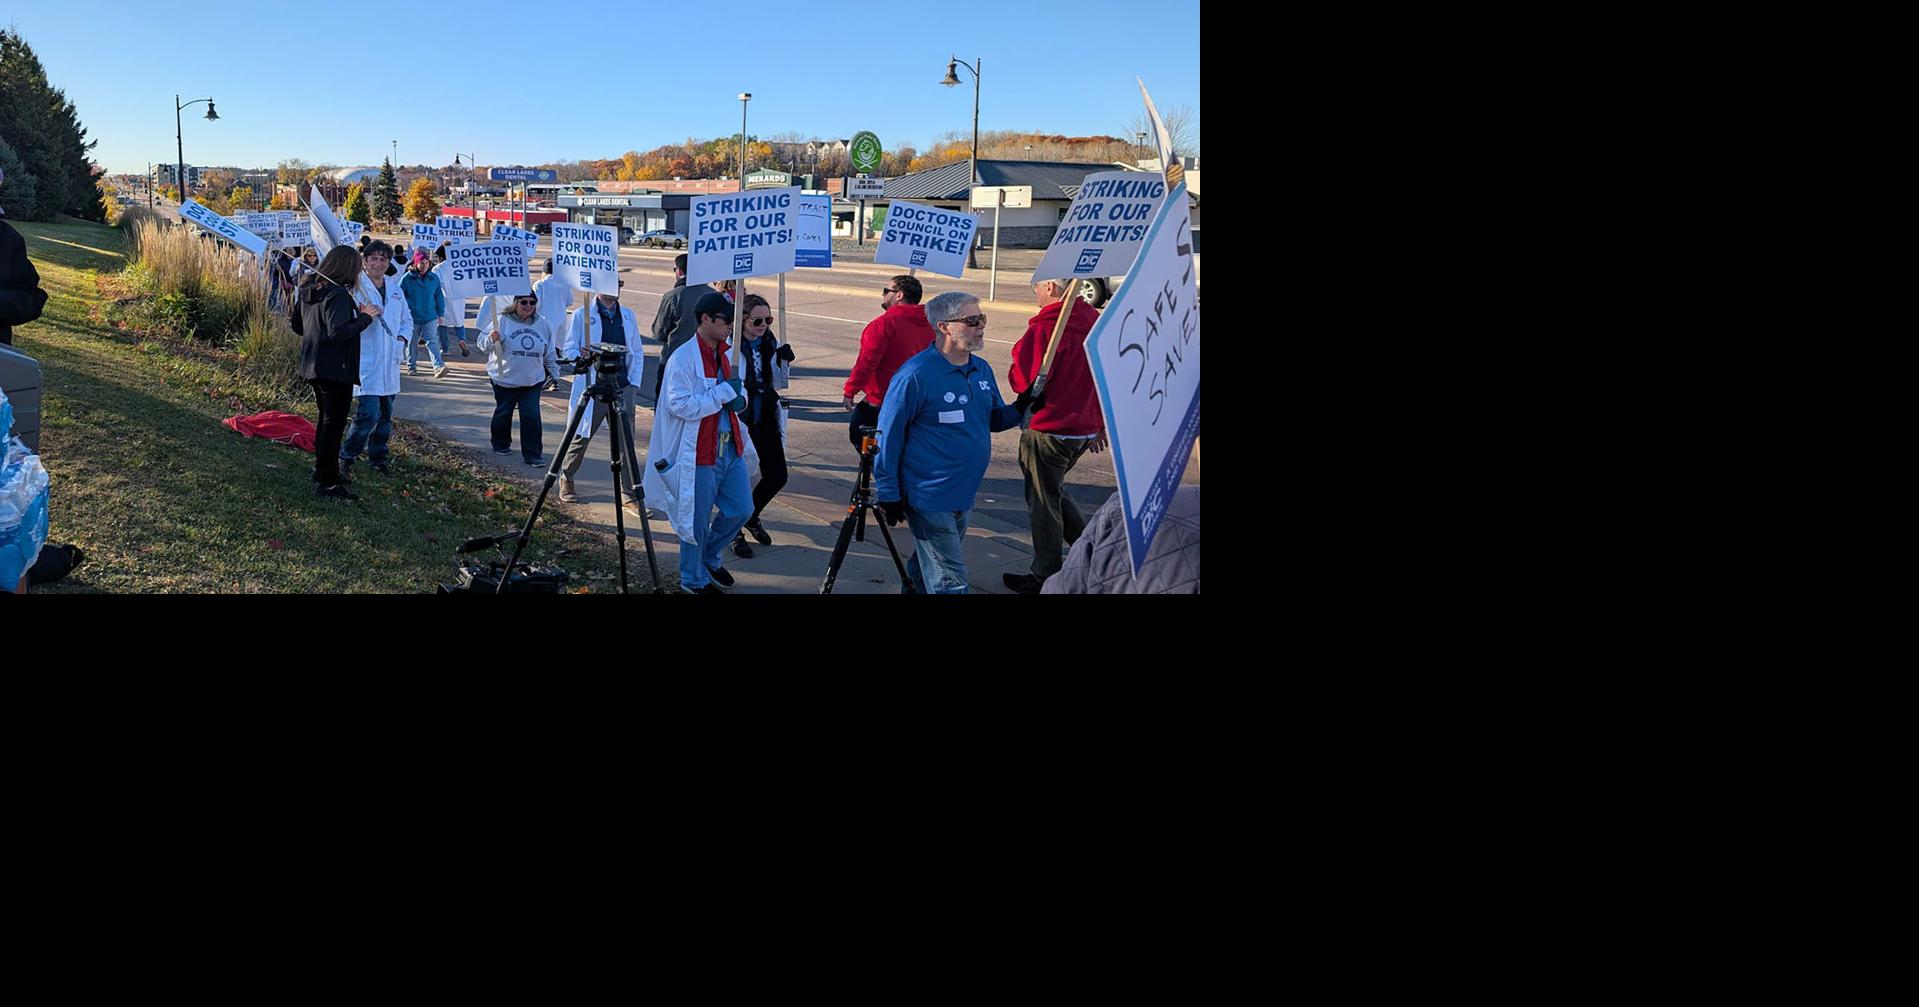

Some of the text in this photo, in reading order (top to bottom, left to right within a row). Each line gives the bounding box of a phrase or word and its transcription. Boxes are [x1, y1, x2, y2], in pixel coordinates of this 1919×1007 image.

[748, 174, 786, 182] MENARDS
[1078, 180, 1164, 200] STRIKING
[695, 193, 791, 218] STRIKING
[1068, 202, 1152, 222] FOR OUR
[438, 219, 473, 230] ULP
[698, 212, 786, 236] FOR OUR
[892, 206, 972, 230] DOCTORS
[416, 225, 437, 236] UL
[438, 230, 473, 238] STRIKE!
[496, 226, 536, 240] ULP
[556, 227, 612, 242] STRIKING
[889, 219, 970, 241] COUNCIL ON
[1054, 225, 1151, 246] PATIENTS!
[558, 241, 610, 256] FOR OUR
[694, 229, 793, 254] PATIENTS!
[886, 229, 966, 255] STRIKE!
[450, 246, 522, 259] DOCTORS
[451, 259, 504, 268] COUNCIL
[556, 254, 615, 272] PATIENTS!
[453, 266, 524, 280] STRIKE!
[1118, 280, 1178, 394] SAFE
